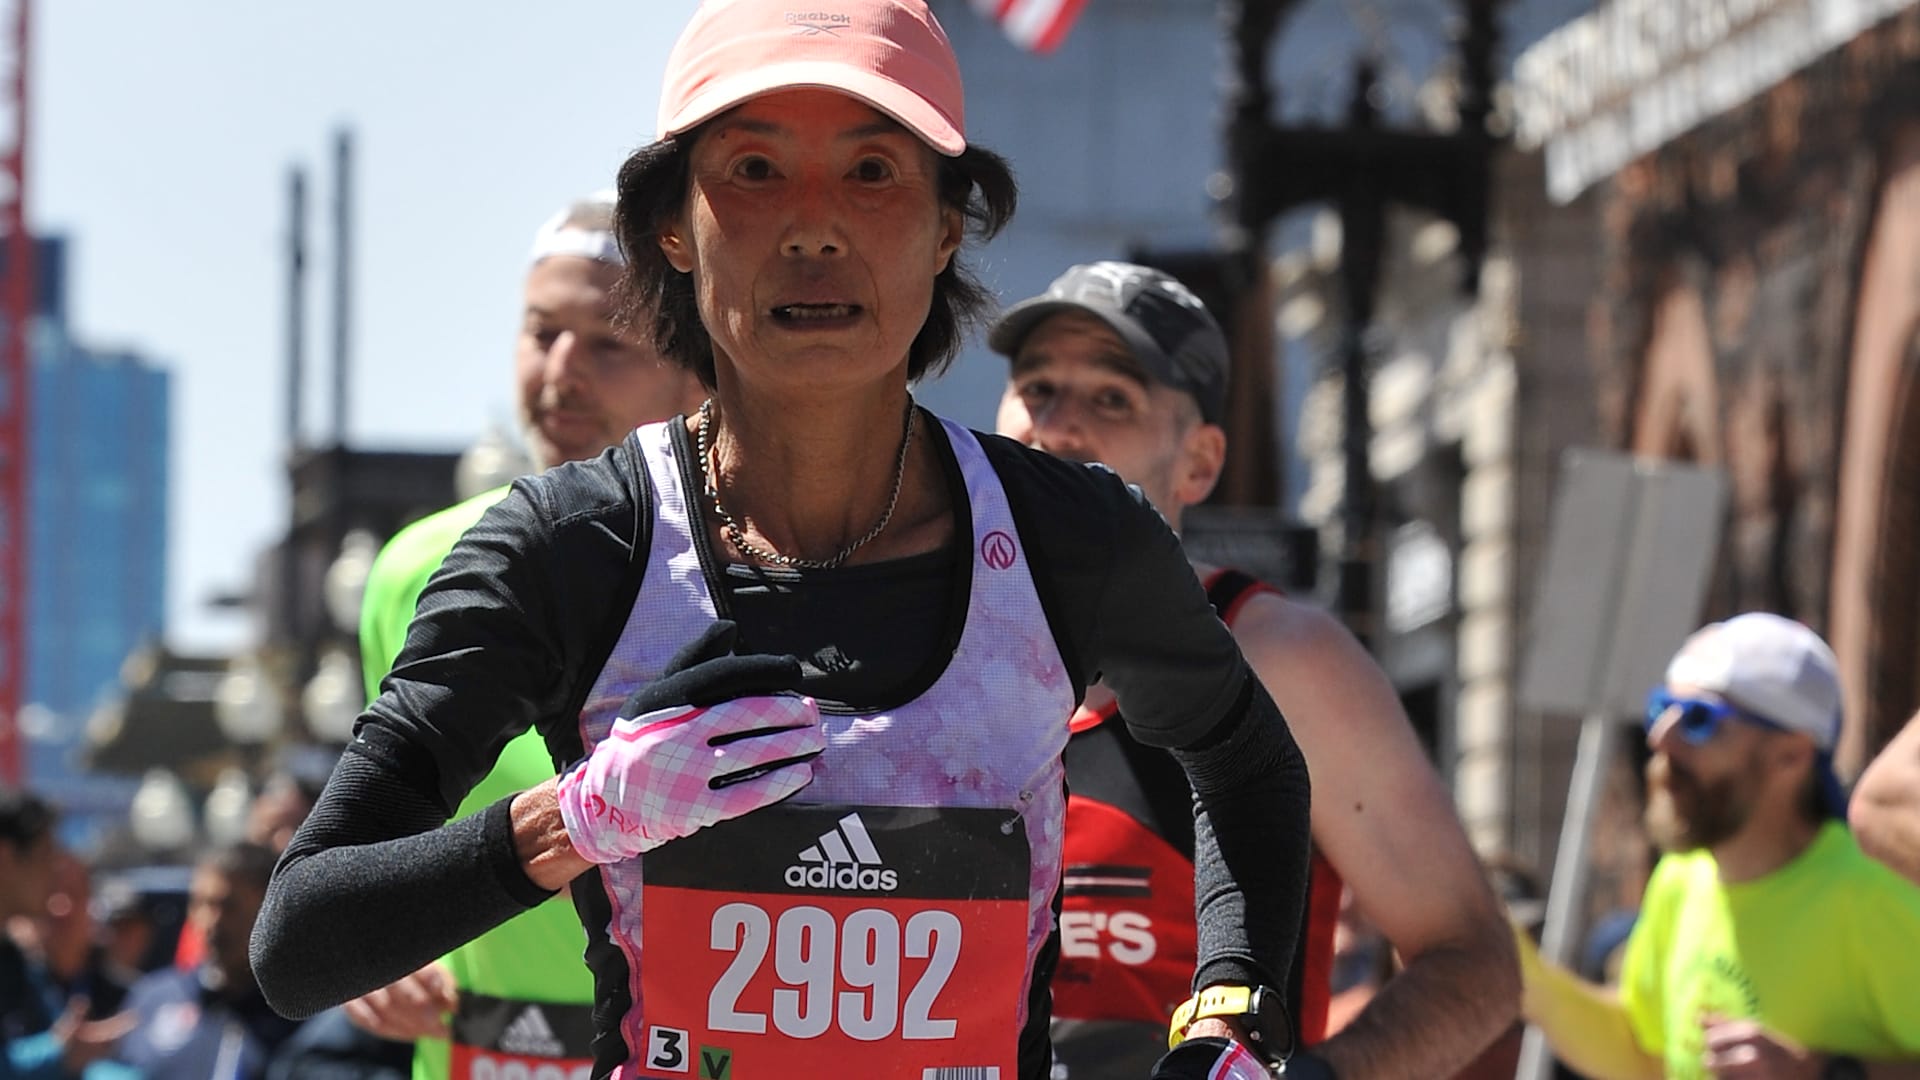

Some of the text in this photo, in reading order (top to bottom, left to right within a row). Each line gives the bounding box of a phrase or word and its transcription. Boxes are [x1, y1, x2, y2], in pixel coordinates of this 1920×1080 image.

[785, 11, 851, 24] Reebok
[784, 861, 898, 891] adidas
[708, 902, 962, 1041] 2992
[652, 1030, 683, 1068] 3
[702, 1052, 730, 1080] V
